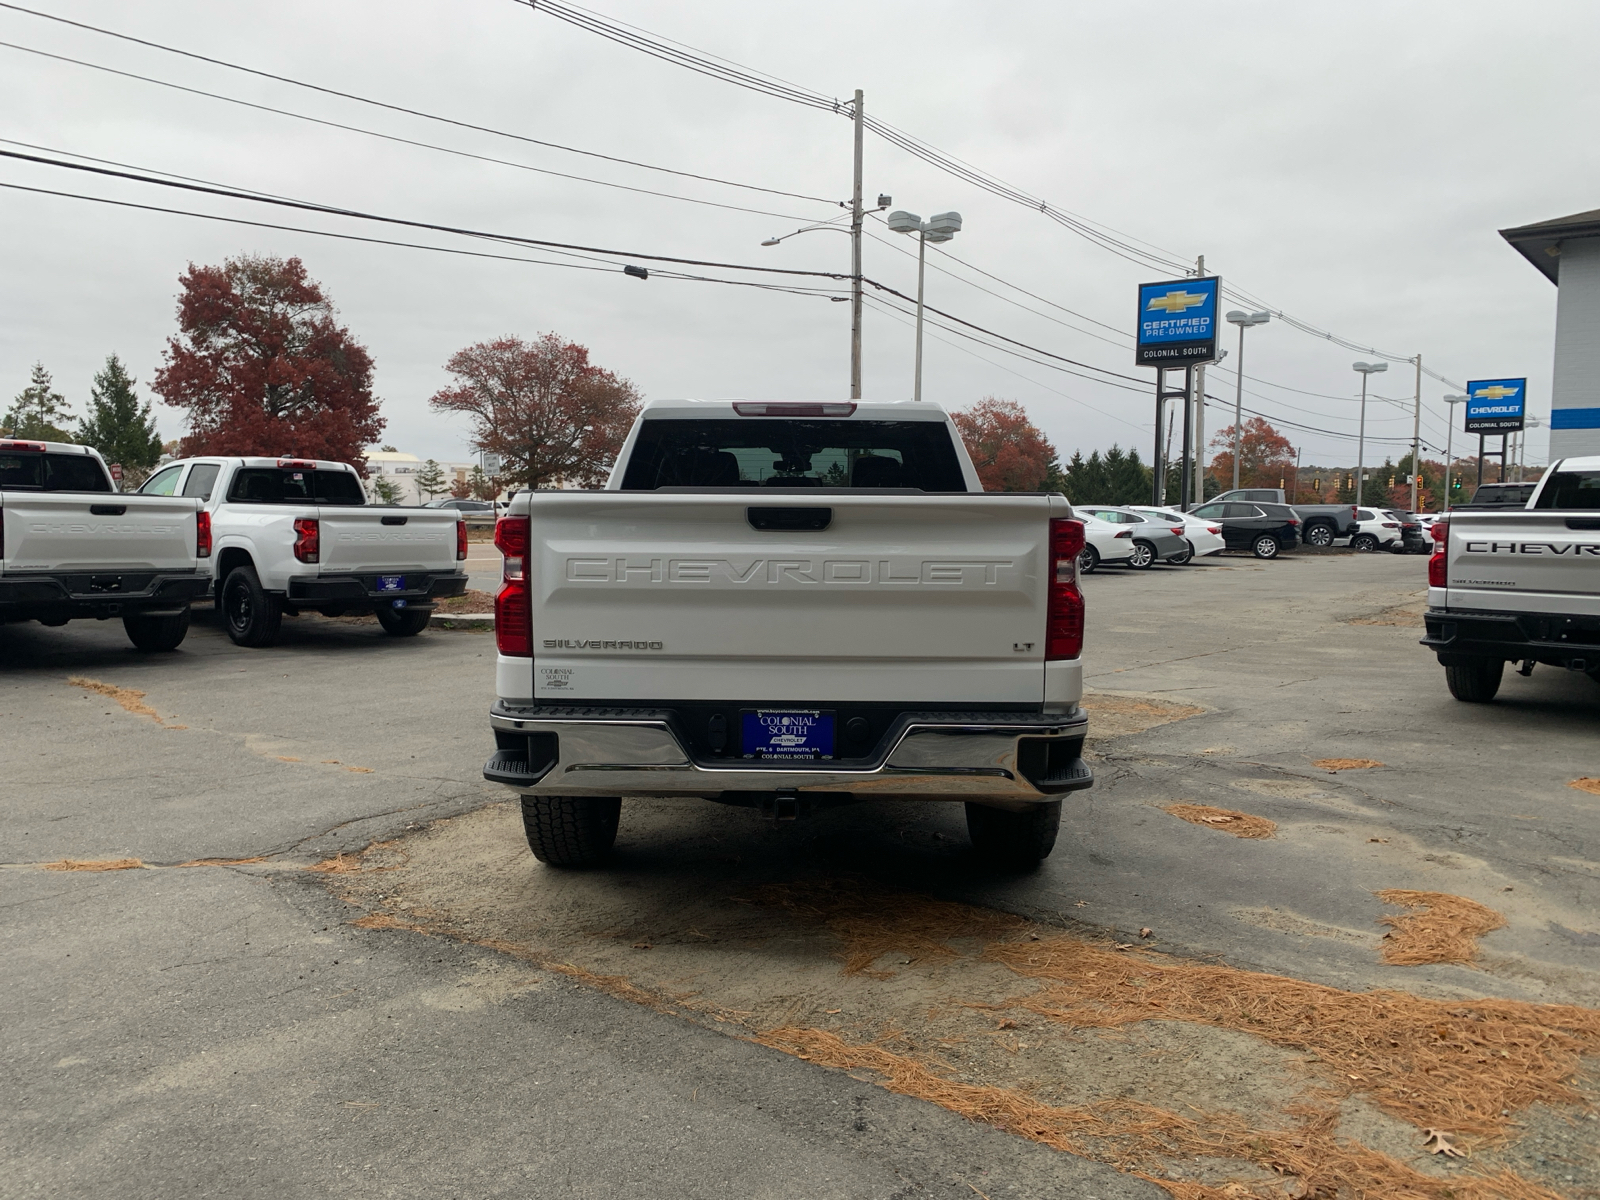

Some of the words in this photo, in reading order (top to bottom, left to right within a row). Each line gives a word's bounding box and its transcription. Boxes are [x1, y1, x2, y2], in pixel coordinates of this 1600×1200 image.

[1143, 317, 1210, 330] CERTIFIED
[1145, 325, 1207, 337] PRE-OWNED
[1143, 349, 1179, 358] COLONIAL
[1182, 347, 1207, 356] SOUTH
[1470, 405, 1521, 414] CHEVROLET
[29, 523, 181, 535] CHEVROLET
[338, 532, 447, 541] CHEVROLET
[566, 558, 1013, 584] CHEVROLET
[543, 639, 664, 650] SILVERADO
[1013, 642, 1035, 652] LT
[760, 716, 817, 726] COLONIAL
[768, 726, 808, 735] SOUTH
